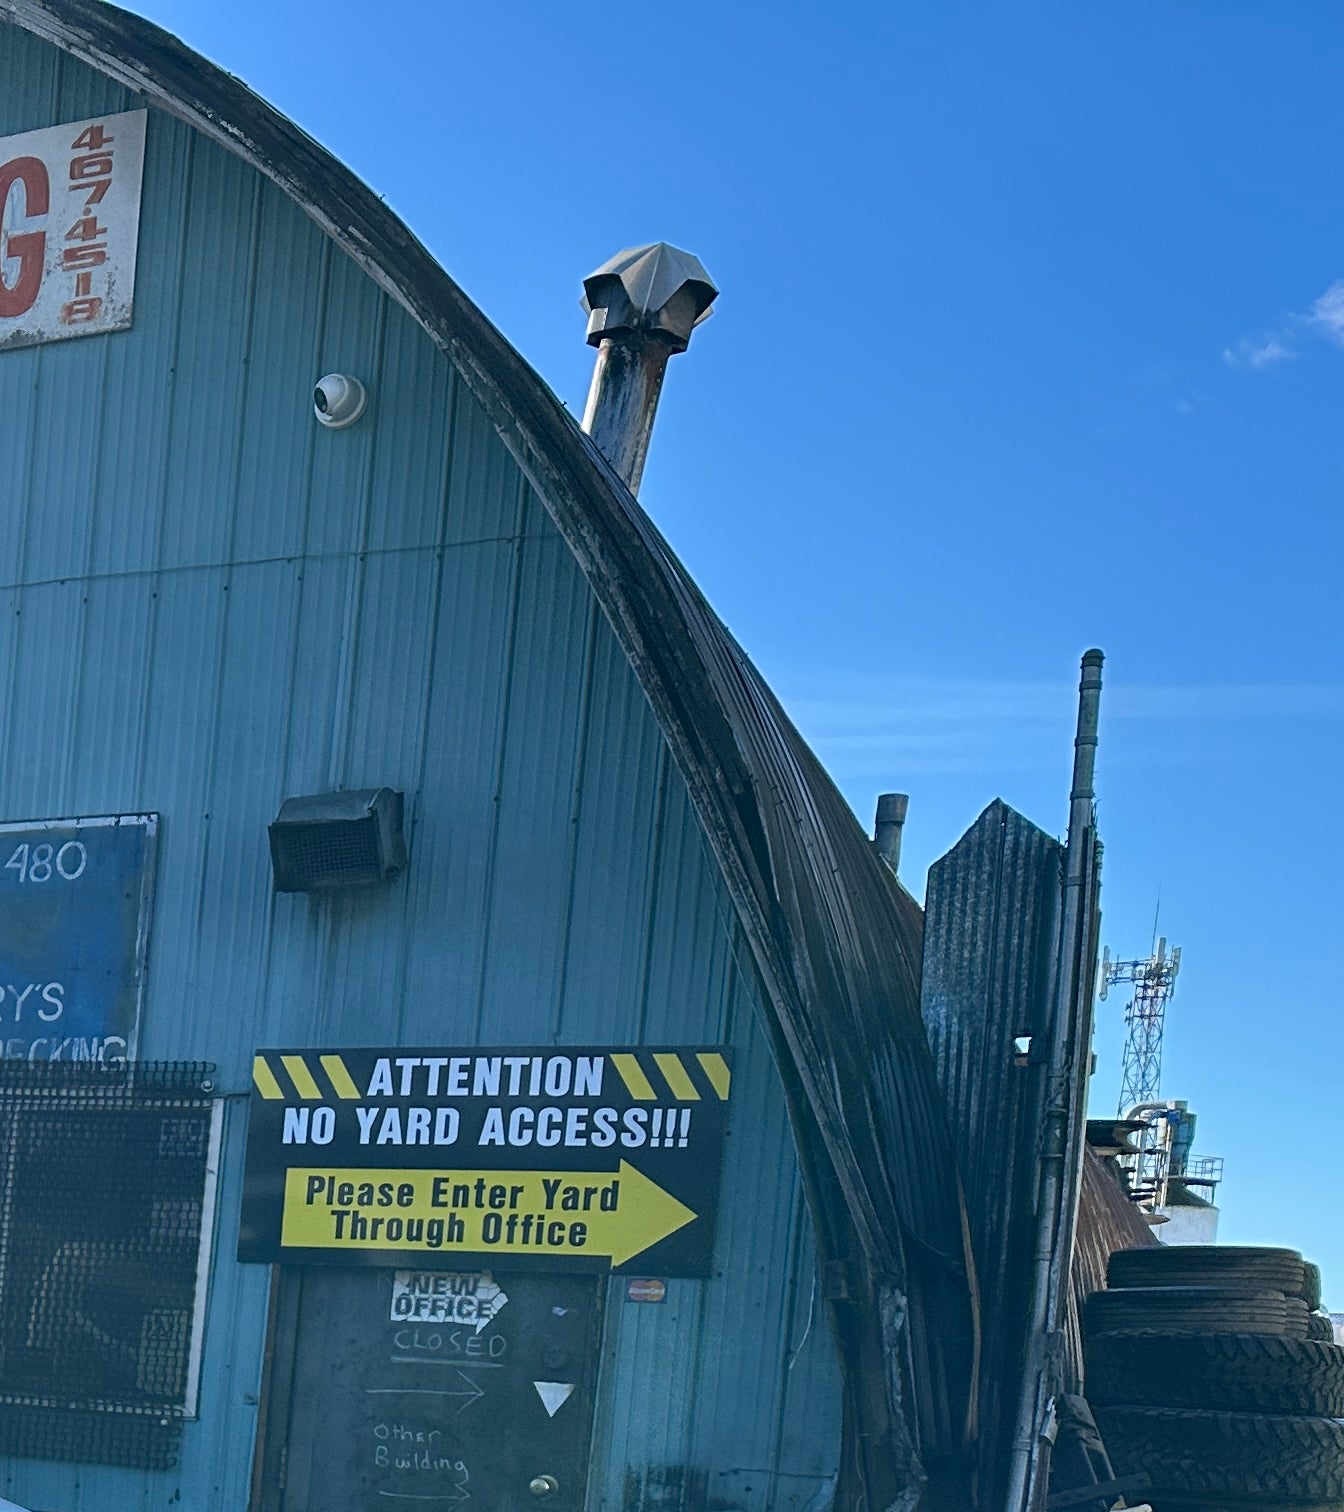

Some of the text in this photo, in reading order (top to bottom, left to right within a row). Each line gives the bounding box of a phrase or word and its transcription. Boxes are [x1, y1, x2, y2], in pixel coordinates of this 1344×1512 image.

[367, 1055, 605, 1099] ATTENTION
[281, 1106, 693, 1149] NO YARD ACCESS!!!
[305, 1175, 621, 1213] Please Enter Yard
[330, 1210, 588, 1248] Through Office
[410, 1274, 480, 1296] NEW
[394, 1294, 494, 1319] OFFICE
[393, 1329, 507, 1357] CLOSED
[374, 1424, 442, 1443] Other
[374, 1446, 469, 1484] Building
